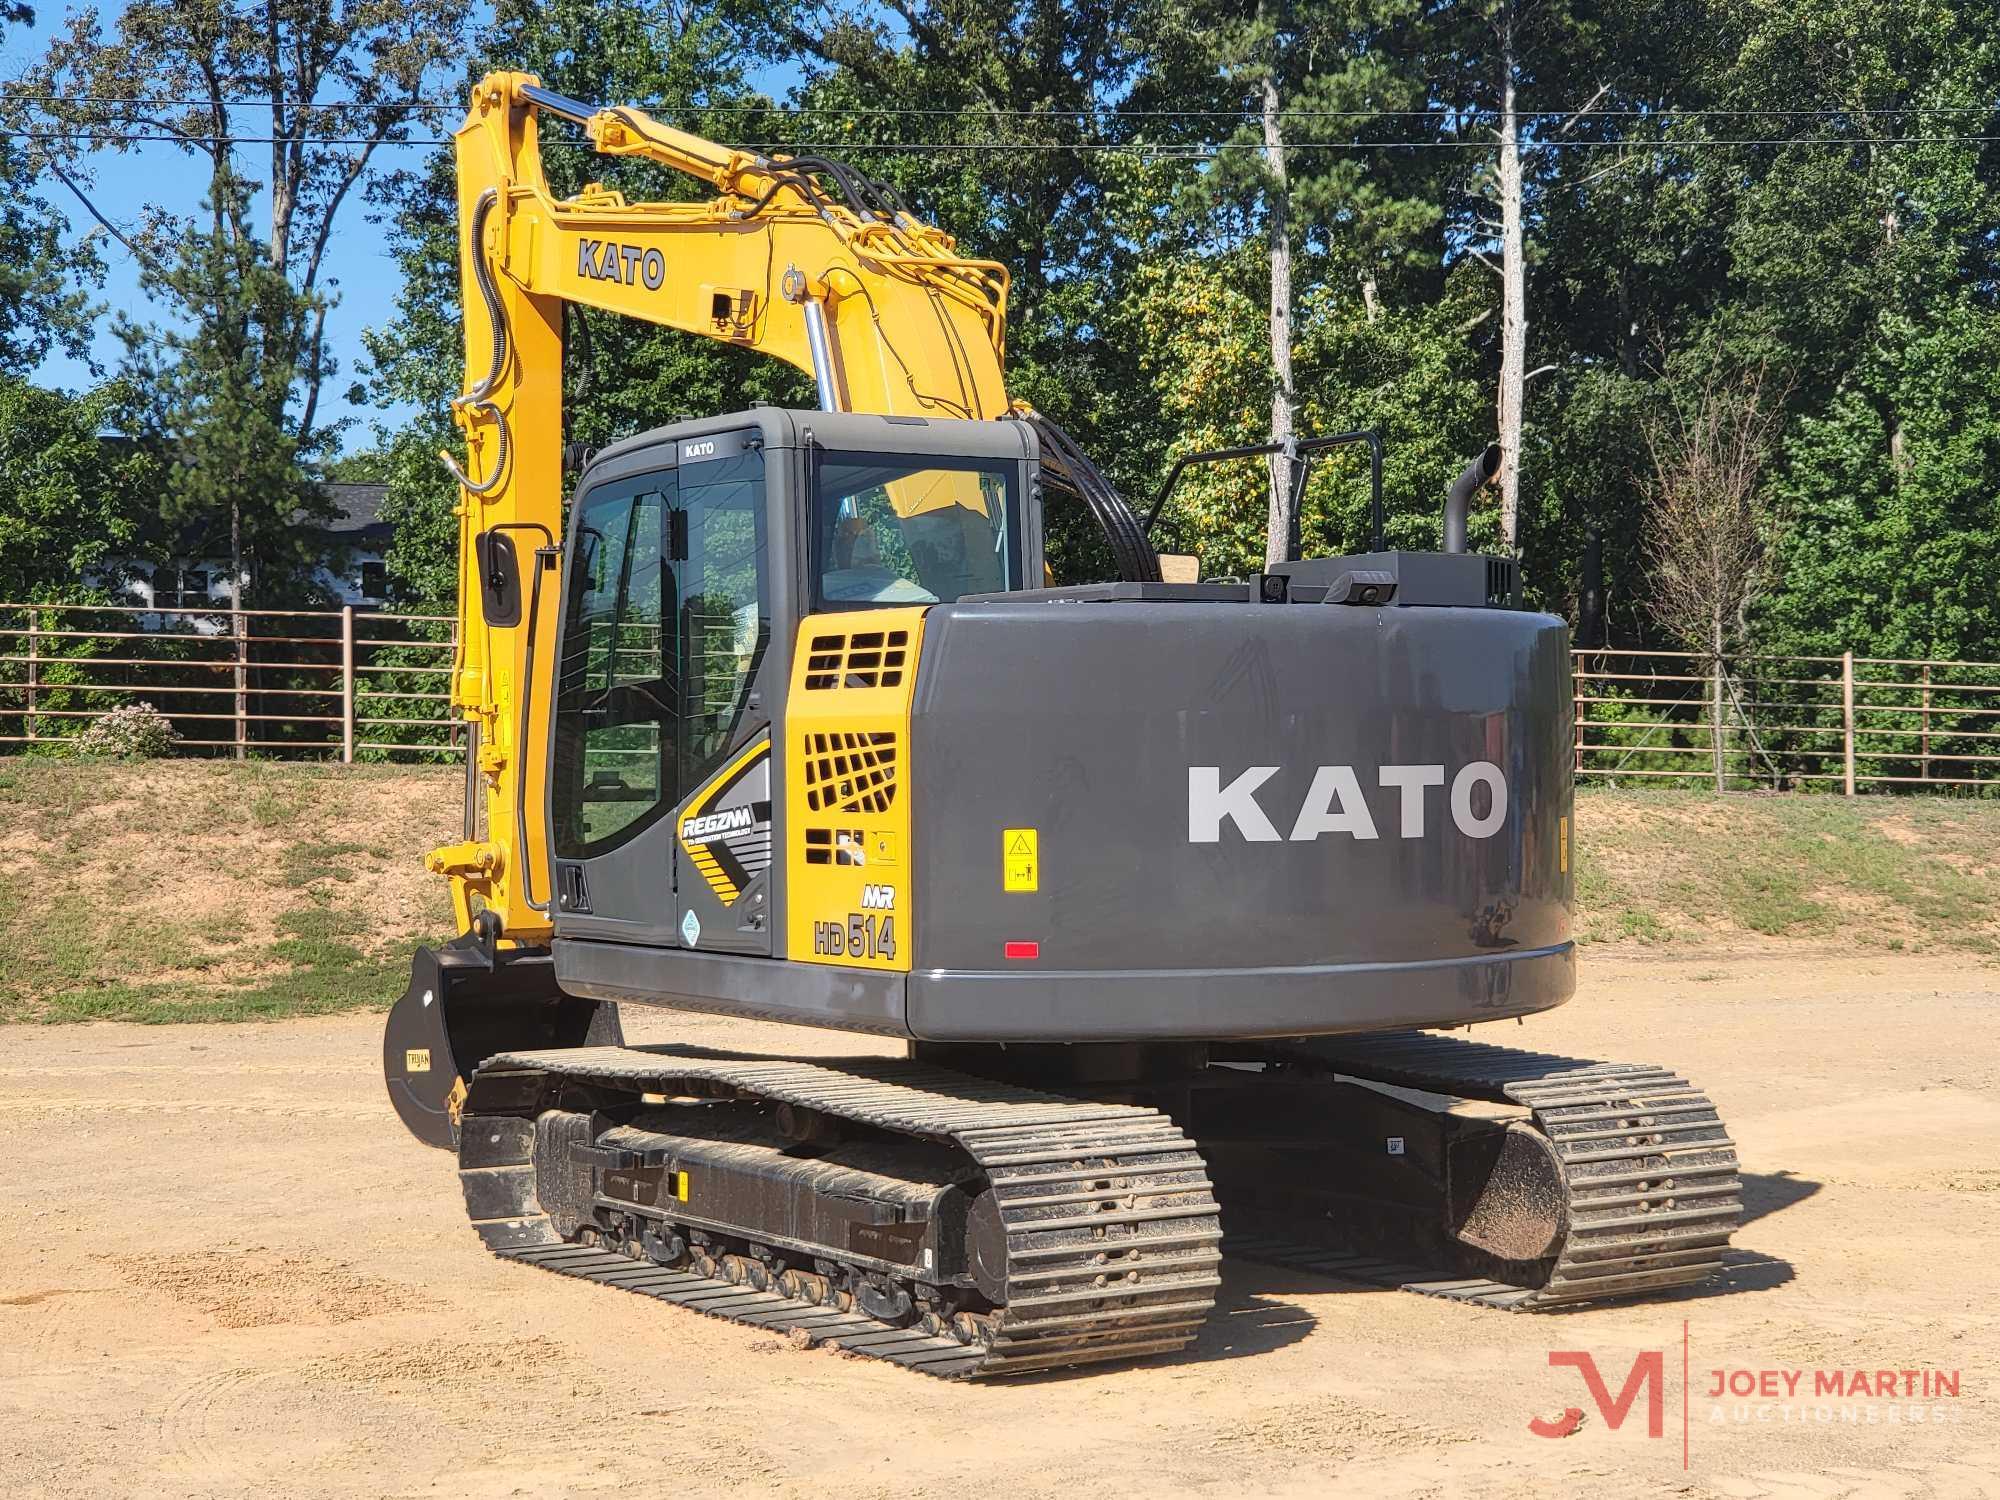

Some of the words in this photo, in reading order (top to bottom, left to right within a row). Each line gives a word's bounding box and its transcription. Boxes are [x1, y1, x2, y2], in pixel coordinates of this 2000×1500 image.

[577, 238, 666, 291] KATO
[685, 441, 715, 458] KATO
[1188, 761, 1508, 843] KATO
[862, 884, 896, 910] MR
[814, 913, 897, 961] HD514
